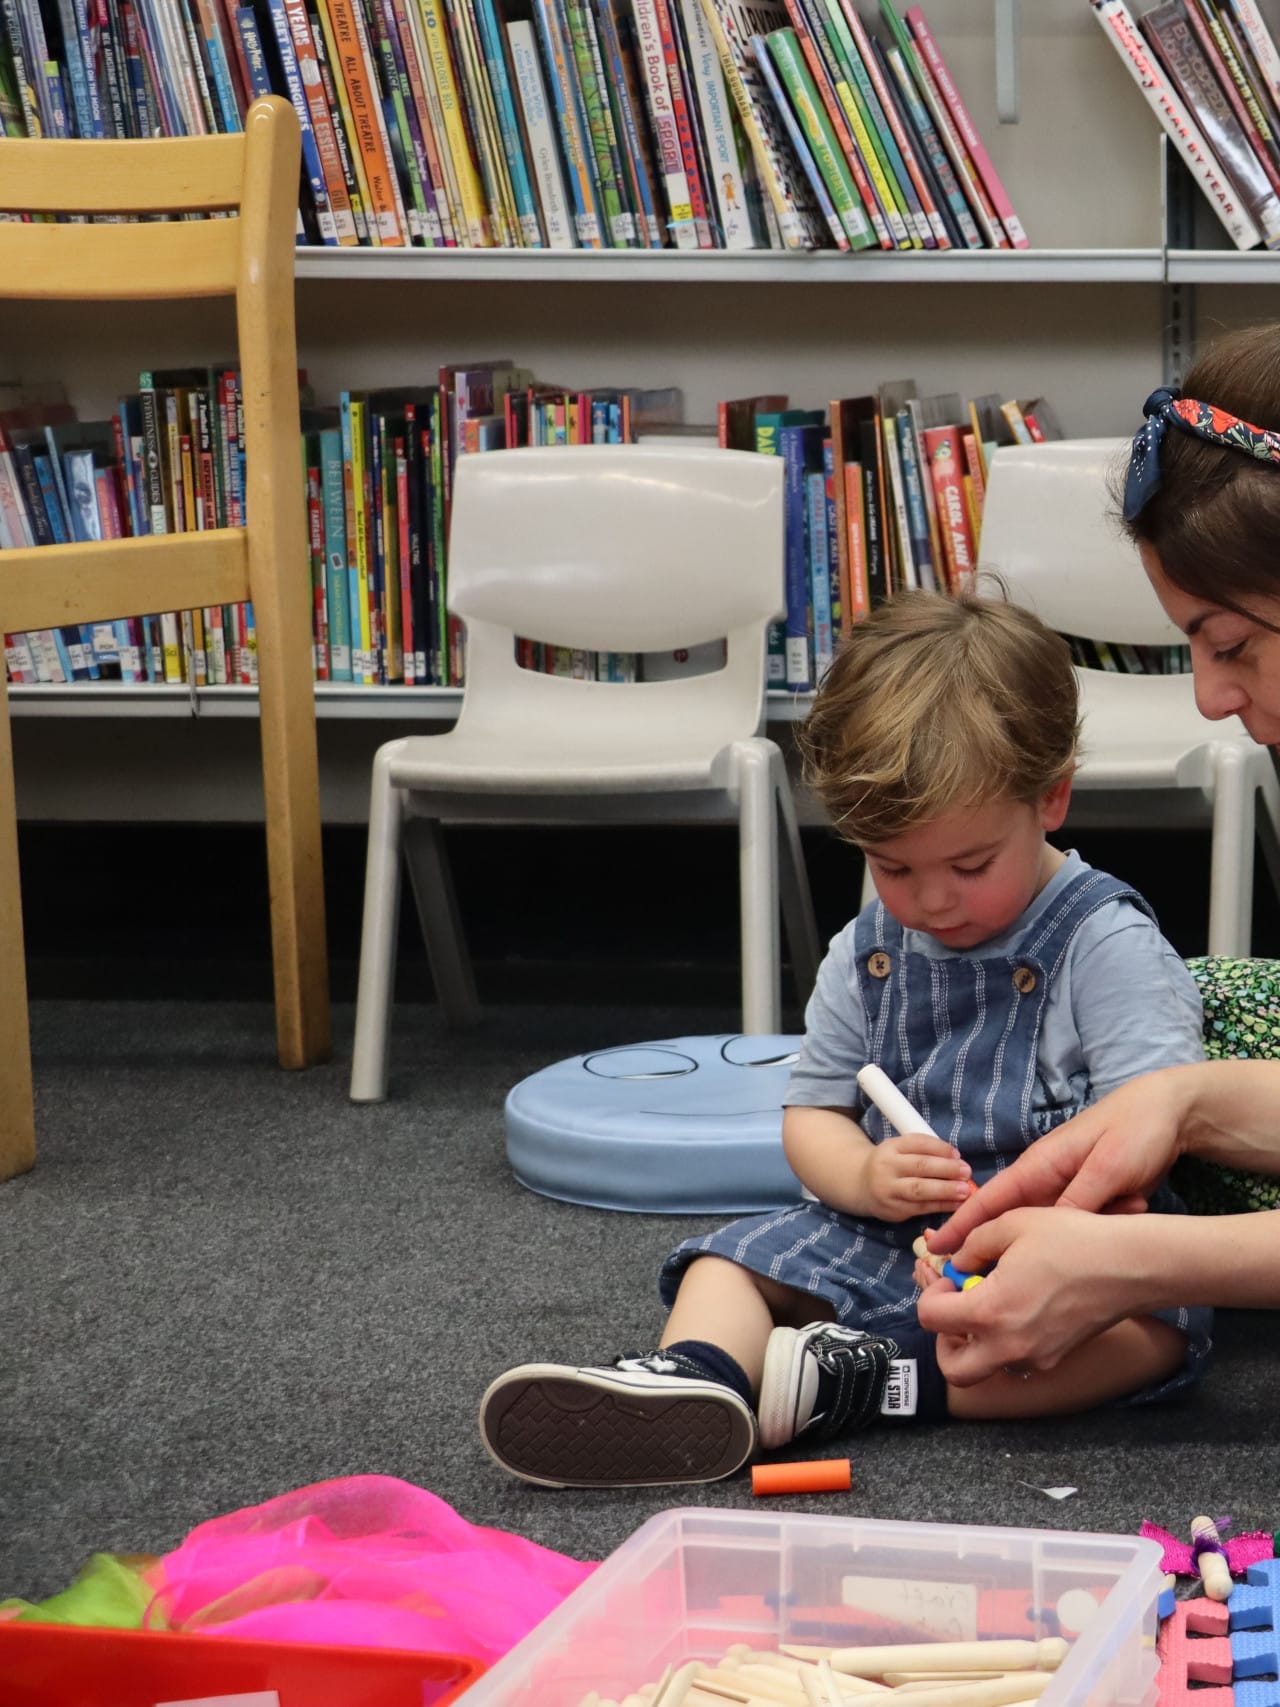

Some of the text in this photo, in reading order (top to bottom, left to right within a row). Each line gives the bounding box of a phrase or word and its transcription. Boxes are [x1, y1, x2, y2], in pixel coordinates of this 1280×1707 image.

[270, 6, 290, 45] MEET
[634, 0, 657, 53] ldren's
[279, 45, 296, 73] THE
[287, 5, 311, 47] YEARS
[309, 95, 327, 119] THE
[646, 54, 666, 92] Book
[137, 104, 151, 137] ARMSTRON
[654, 94, 668, 111] of
[704, 79, 724, 132] IMPORTANT
[714, 133, 730, 164] SPORT
[1103, 8, 1167, 95] history
[1156, 92, 1191, 140] YEAR
[1185, 141, 1207, 166] BY
[1201, 167, 1236, 216] YEAR
[115, 121, 125, 138] LAND
[143, 395, 159, 504] EYEWITNESS GUIDES
[944, 484, 964, 527] CAROL
[951, 529, 969, 567] ANN
[888, 1365, 901, 1410] ALL STAR
